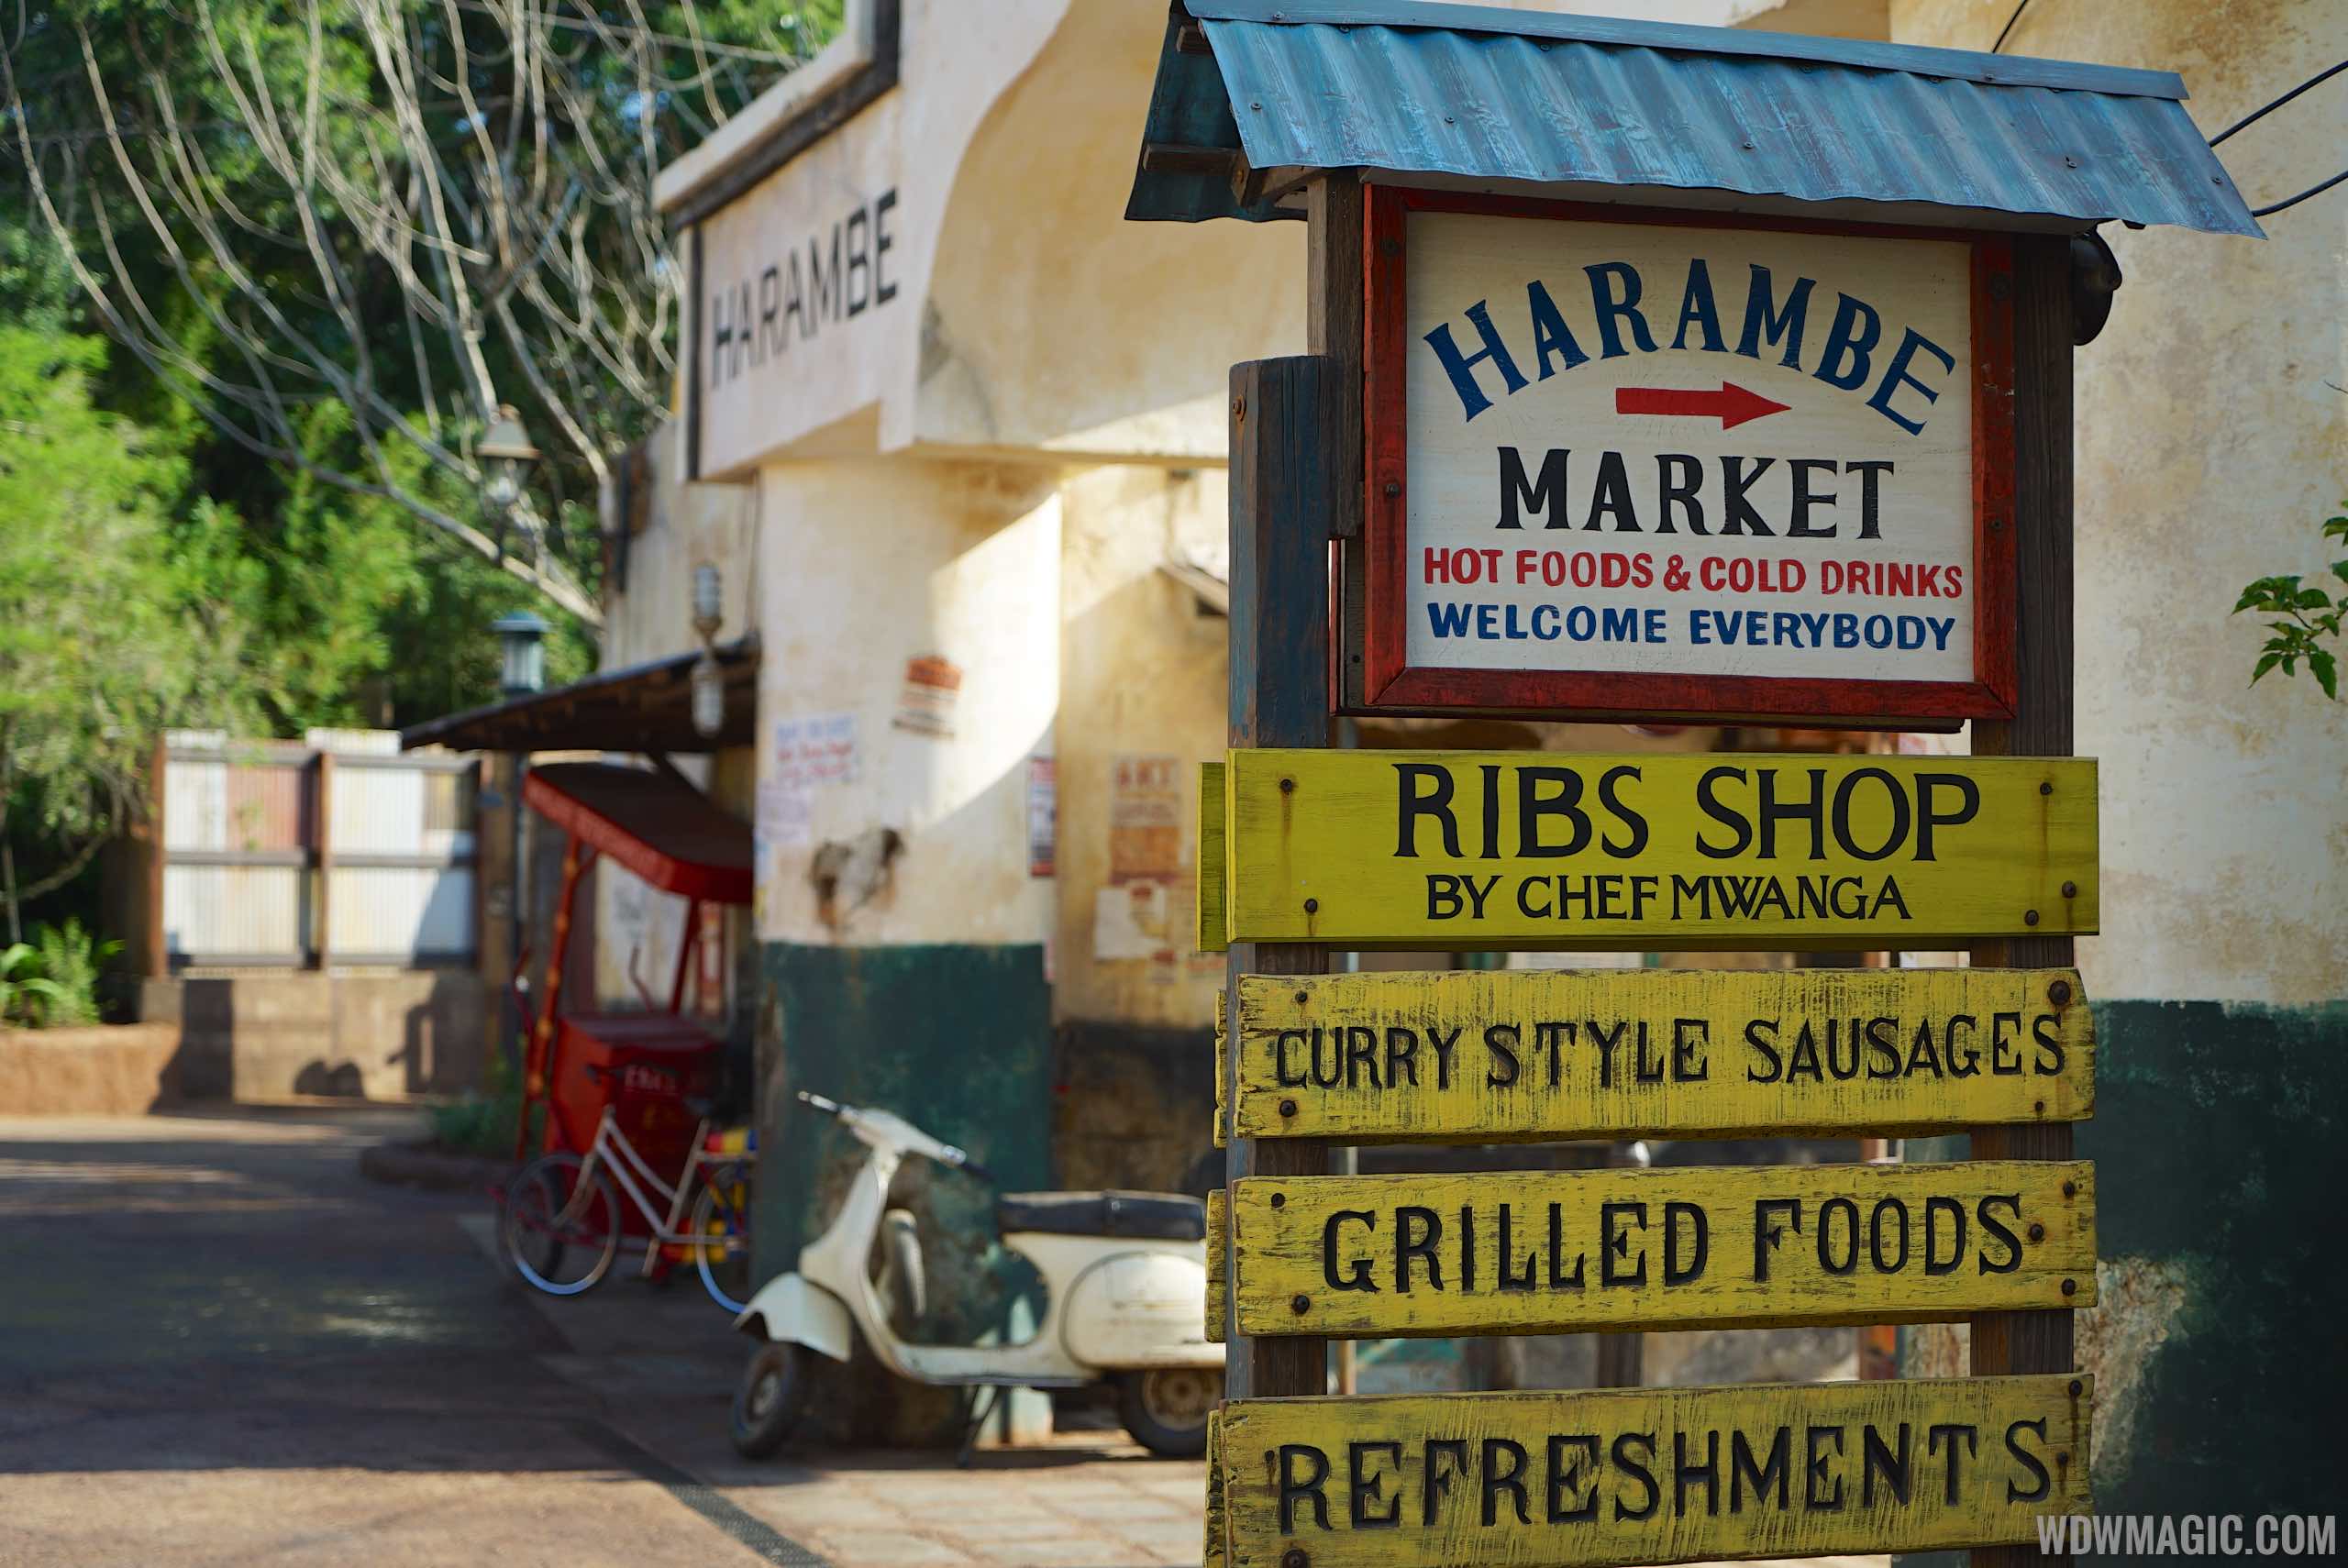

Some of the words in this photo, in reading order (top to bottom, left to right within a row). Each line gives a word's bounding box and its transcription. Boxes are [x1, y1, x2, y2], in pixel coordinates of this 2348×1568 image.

[710, 187, 899, 389] HARAMBE
[1423, 259, 1956, 436] HARAMBE
[1495, 447, 1896, 539] MARKET
[1424, 547, 1503, 584] HOT
[1516, 550, 1654, 588] FOODS
[1663, 555, 1691, 591] &
[1700, 556, 1806, 594] COLD
[1821, 559, 1963, 599] DRINKS
[1427, 602, 1667, 644] WELCOME
[1691, 609, 1956, 651] EVERYBODY
[1391, 763, 1651, 860] RIBS
[1695, 767, 1981, 863] SHOP
[1425, 874, 1503, 921] BY
[1517, 875, 1660, 921] CHEF
[1670, 874, 1912, 921] MWANGA
[1276, 1025, 1463, 1091] CURRY
[1484, 1018, 1711, 1089] STYLE
[1747, 1011, 2067, 1085] SAUSAGES
[1323, 1201, 1710, 1295] GRILLED
[1754, 1194, 2024, 1285] FOODS
[1277, 1417, 2052, 1536] REFRESHMENTS
